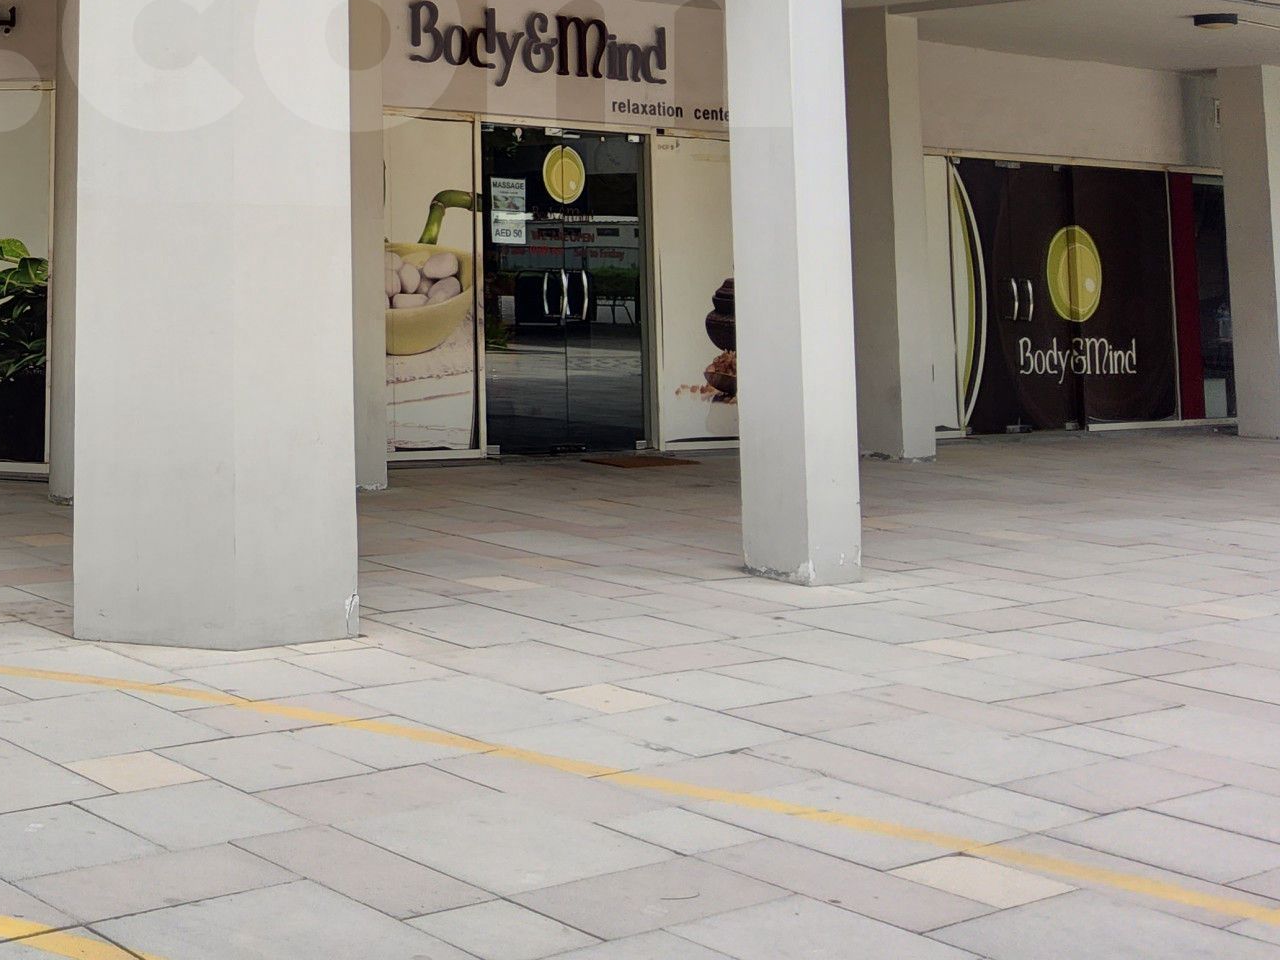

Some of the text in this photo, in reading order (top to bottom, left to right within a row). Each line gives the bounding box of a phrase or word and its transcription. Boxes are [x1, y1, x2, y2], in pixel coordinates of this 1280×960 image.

[612, 99, 730, 121] relaxation cente
[492, 181, 524, 190] MASSAGE
[495, 228, 511, 237] AED
